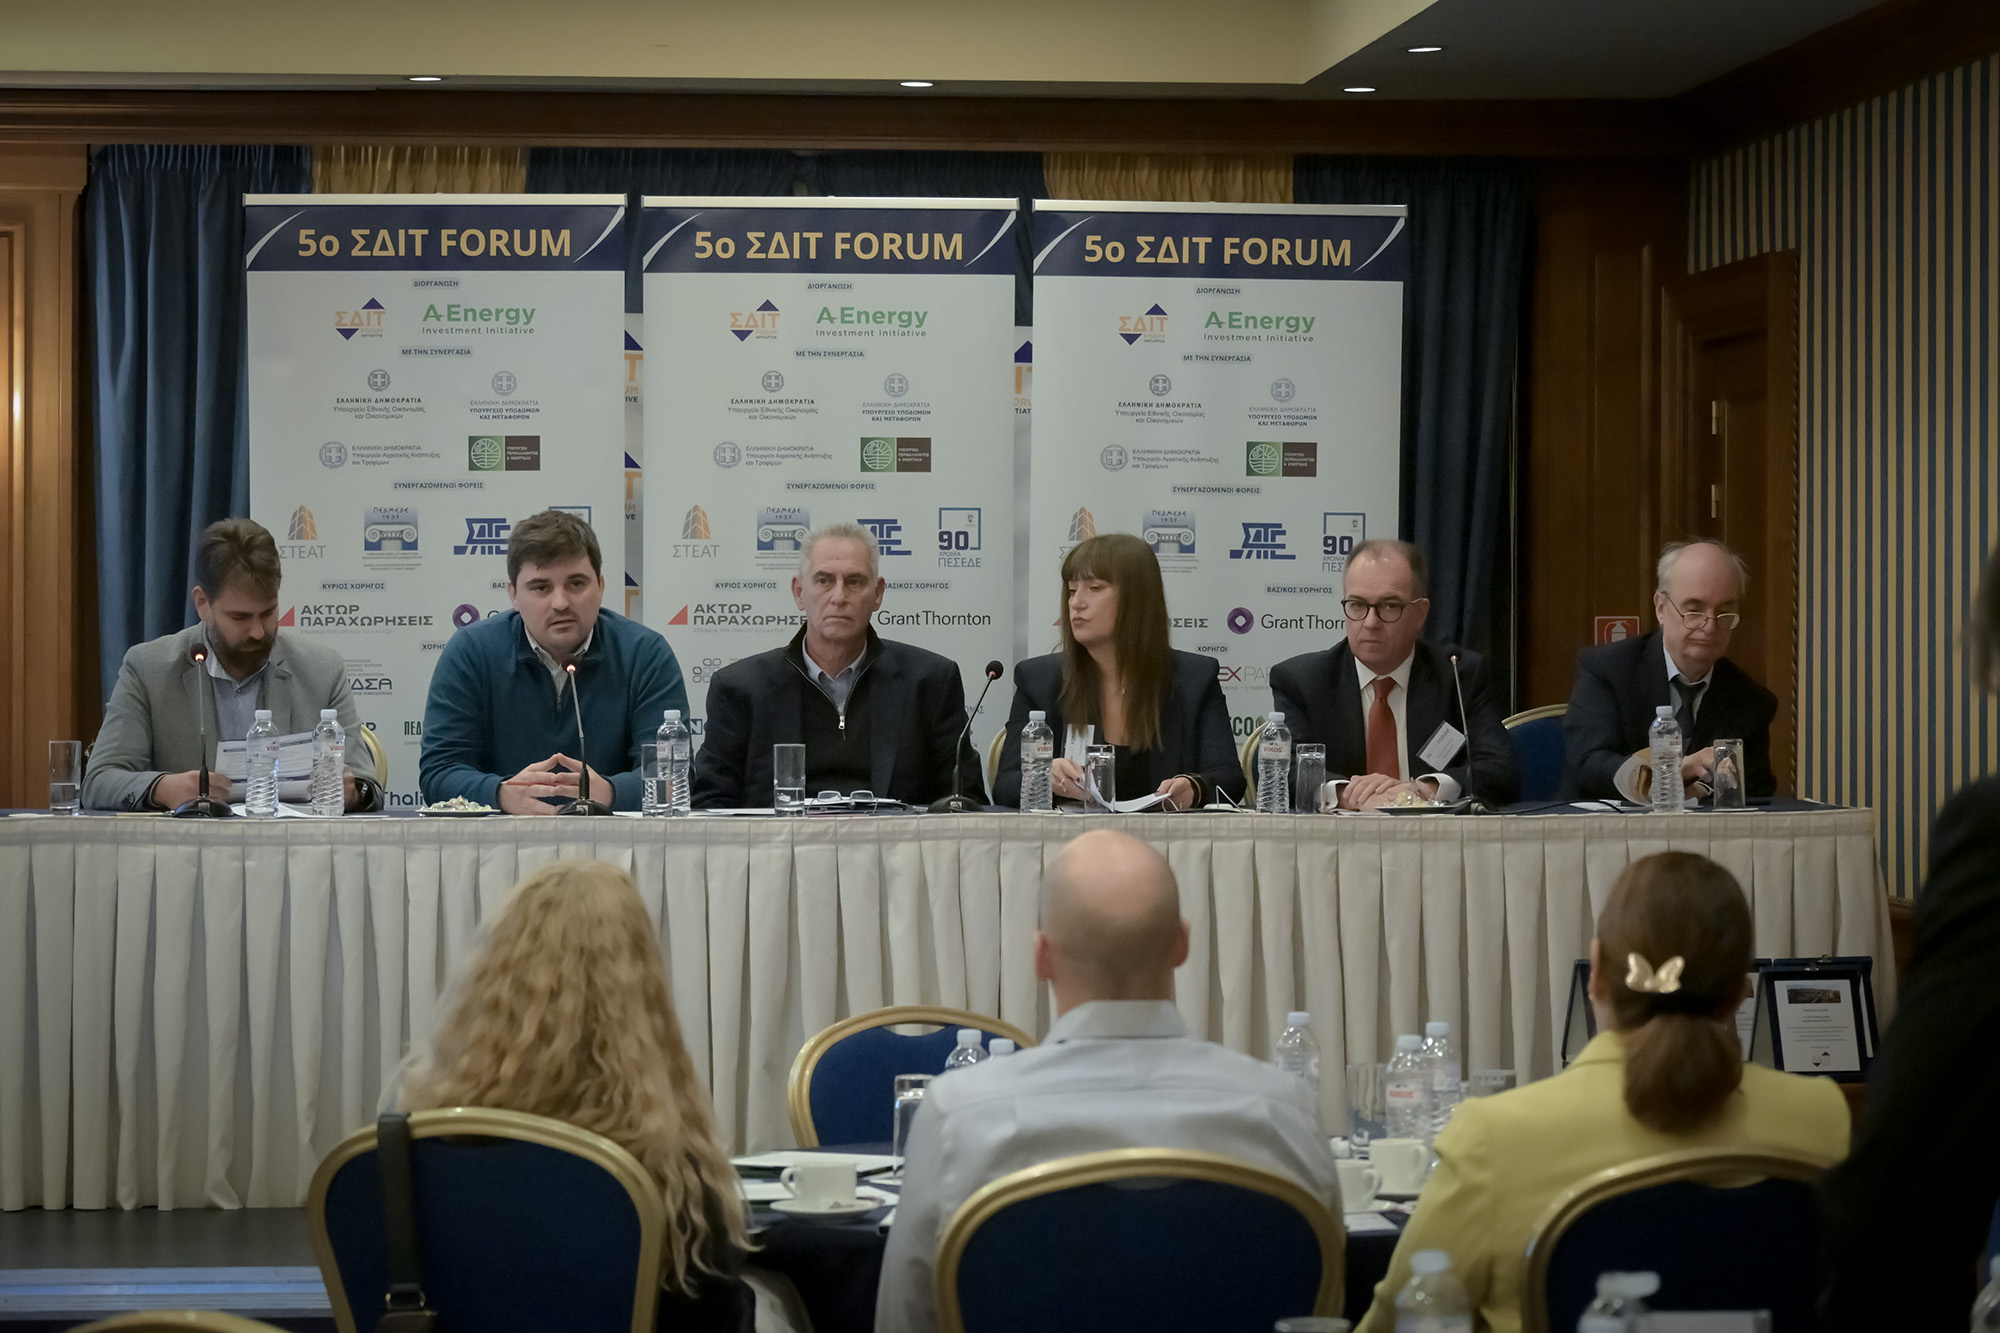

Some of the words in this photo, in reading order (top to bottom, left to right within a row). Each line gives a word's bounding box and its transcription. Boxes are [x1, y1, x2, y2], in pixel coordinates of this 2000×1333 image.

[351, 228, 430, 256] ΣΔΙΤ
[440, 229, 570, 256] FORUM
[747, 232, 823, 260] ΣΔΙΤ
[835, 232, 963, 261] FORUM
[1136, 236, 1212, 264] ΣΔΙΤ
[1224, 238, 1350, 267] FORUM
[335, 310, 387, 328] ΣΔΙΤ
[729, 311, 781, 330] ΣΔΙΤ
[1118, 315, 1168, 334] ΣΔΙΤ
[1267, 333, 1313, 342] Initiative
[1171, 487, 1233, 495] ΣΥΝΕΡΓΑΖΟΜΕΝΟΙ
[938, 530, 969, 551] 90
[1322, 535, 1353, 555] 90
[278, 546, 326, 560] ΣΤΕΑΤ
[673, 545, 720, 558] ΣΤΕΑΤ
[937, 557, 982, 568] ΠΕΣΕΔΕ
[1322, 562, 1344, 573] ΠΕΣ
[915, 581, 949, 590] ΧΟΡΗΓΟΣ
[301, 605, 359, 615] ΑΚΤΩΡ
[694, 604, 752, 613] ΑΚΤΩΡ
[300, 616, 434, 627] ΠΑΡΑΧΩΡΗΣΕΙΣ
[693, 615, 809, 626] ΠΑΡΑΧΩΡΗΣΕ
[878, 610, 920, 627] Grant
[922, 610, 991, 627] Thornton
[1261, 613, 1303, 631] Grant
[1196, 645, 1228, 654] ΧΟΡΗΓΟΙ
[352, 678, 393, 691] ΔΣΑ
